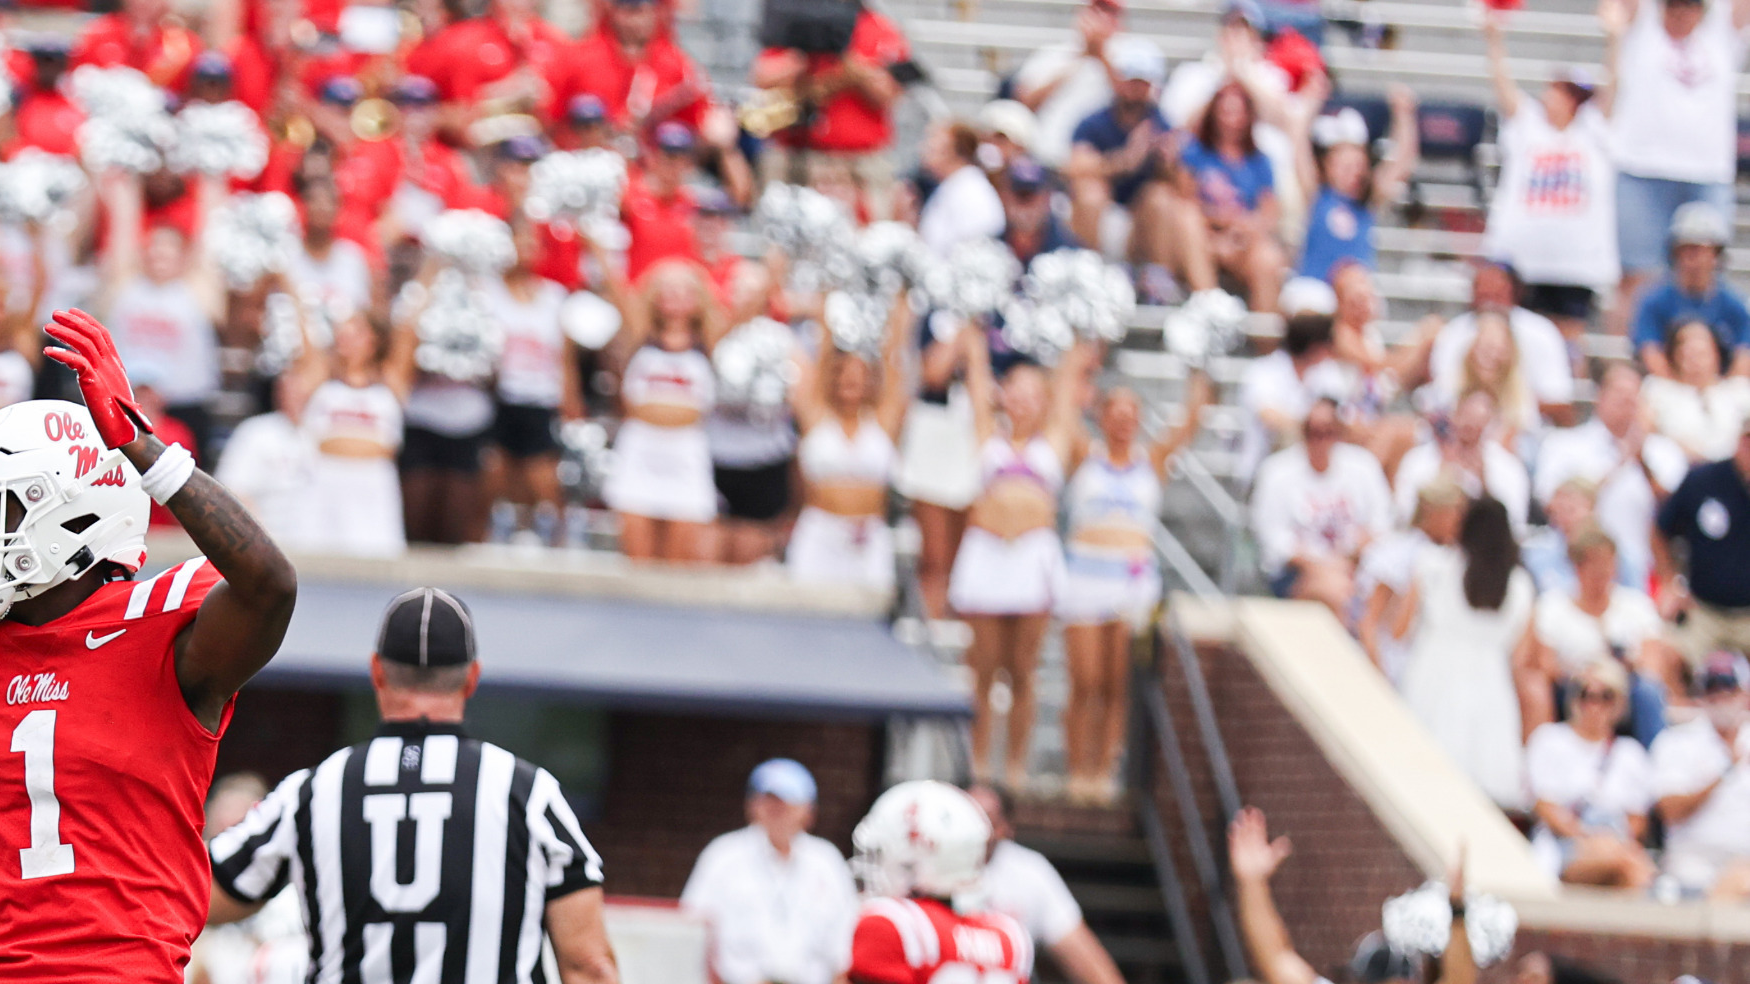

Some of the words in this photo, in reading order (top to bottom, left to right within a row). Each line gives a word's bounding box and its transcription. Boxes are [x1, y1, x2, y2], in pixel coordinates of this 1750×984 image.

[44, 411, 85, 441] Ole
[68, 444, 127, 488] Mss
[6, 675, 32, 705] Ole
[30, 673, 70, 702] Miss
[10, 709, 75, 880] 1
[363, 792, 453, 912] U
